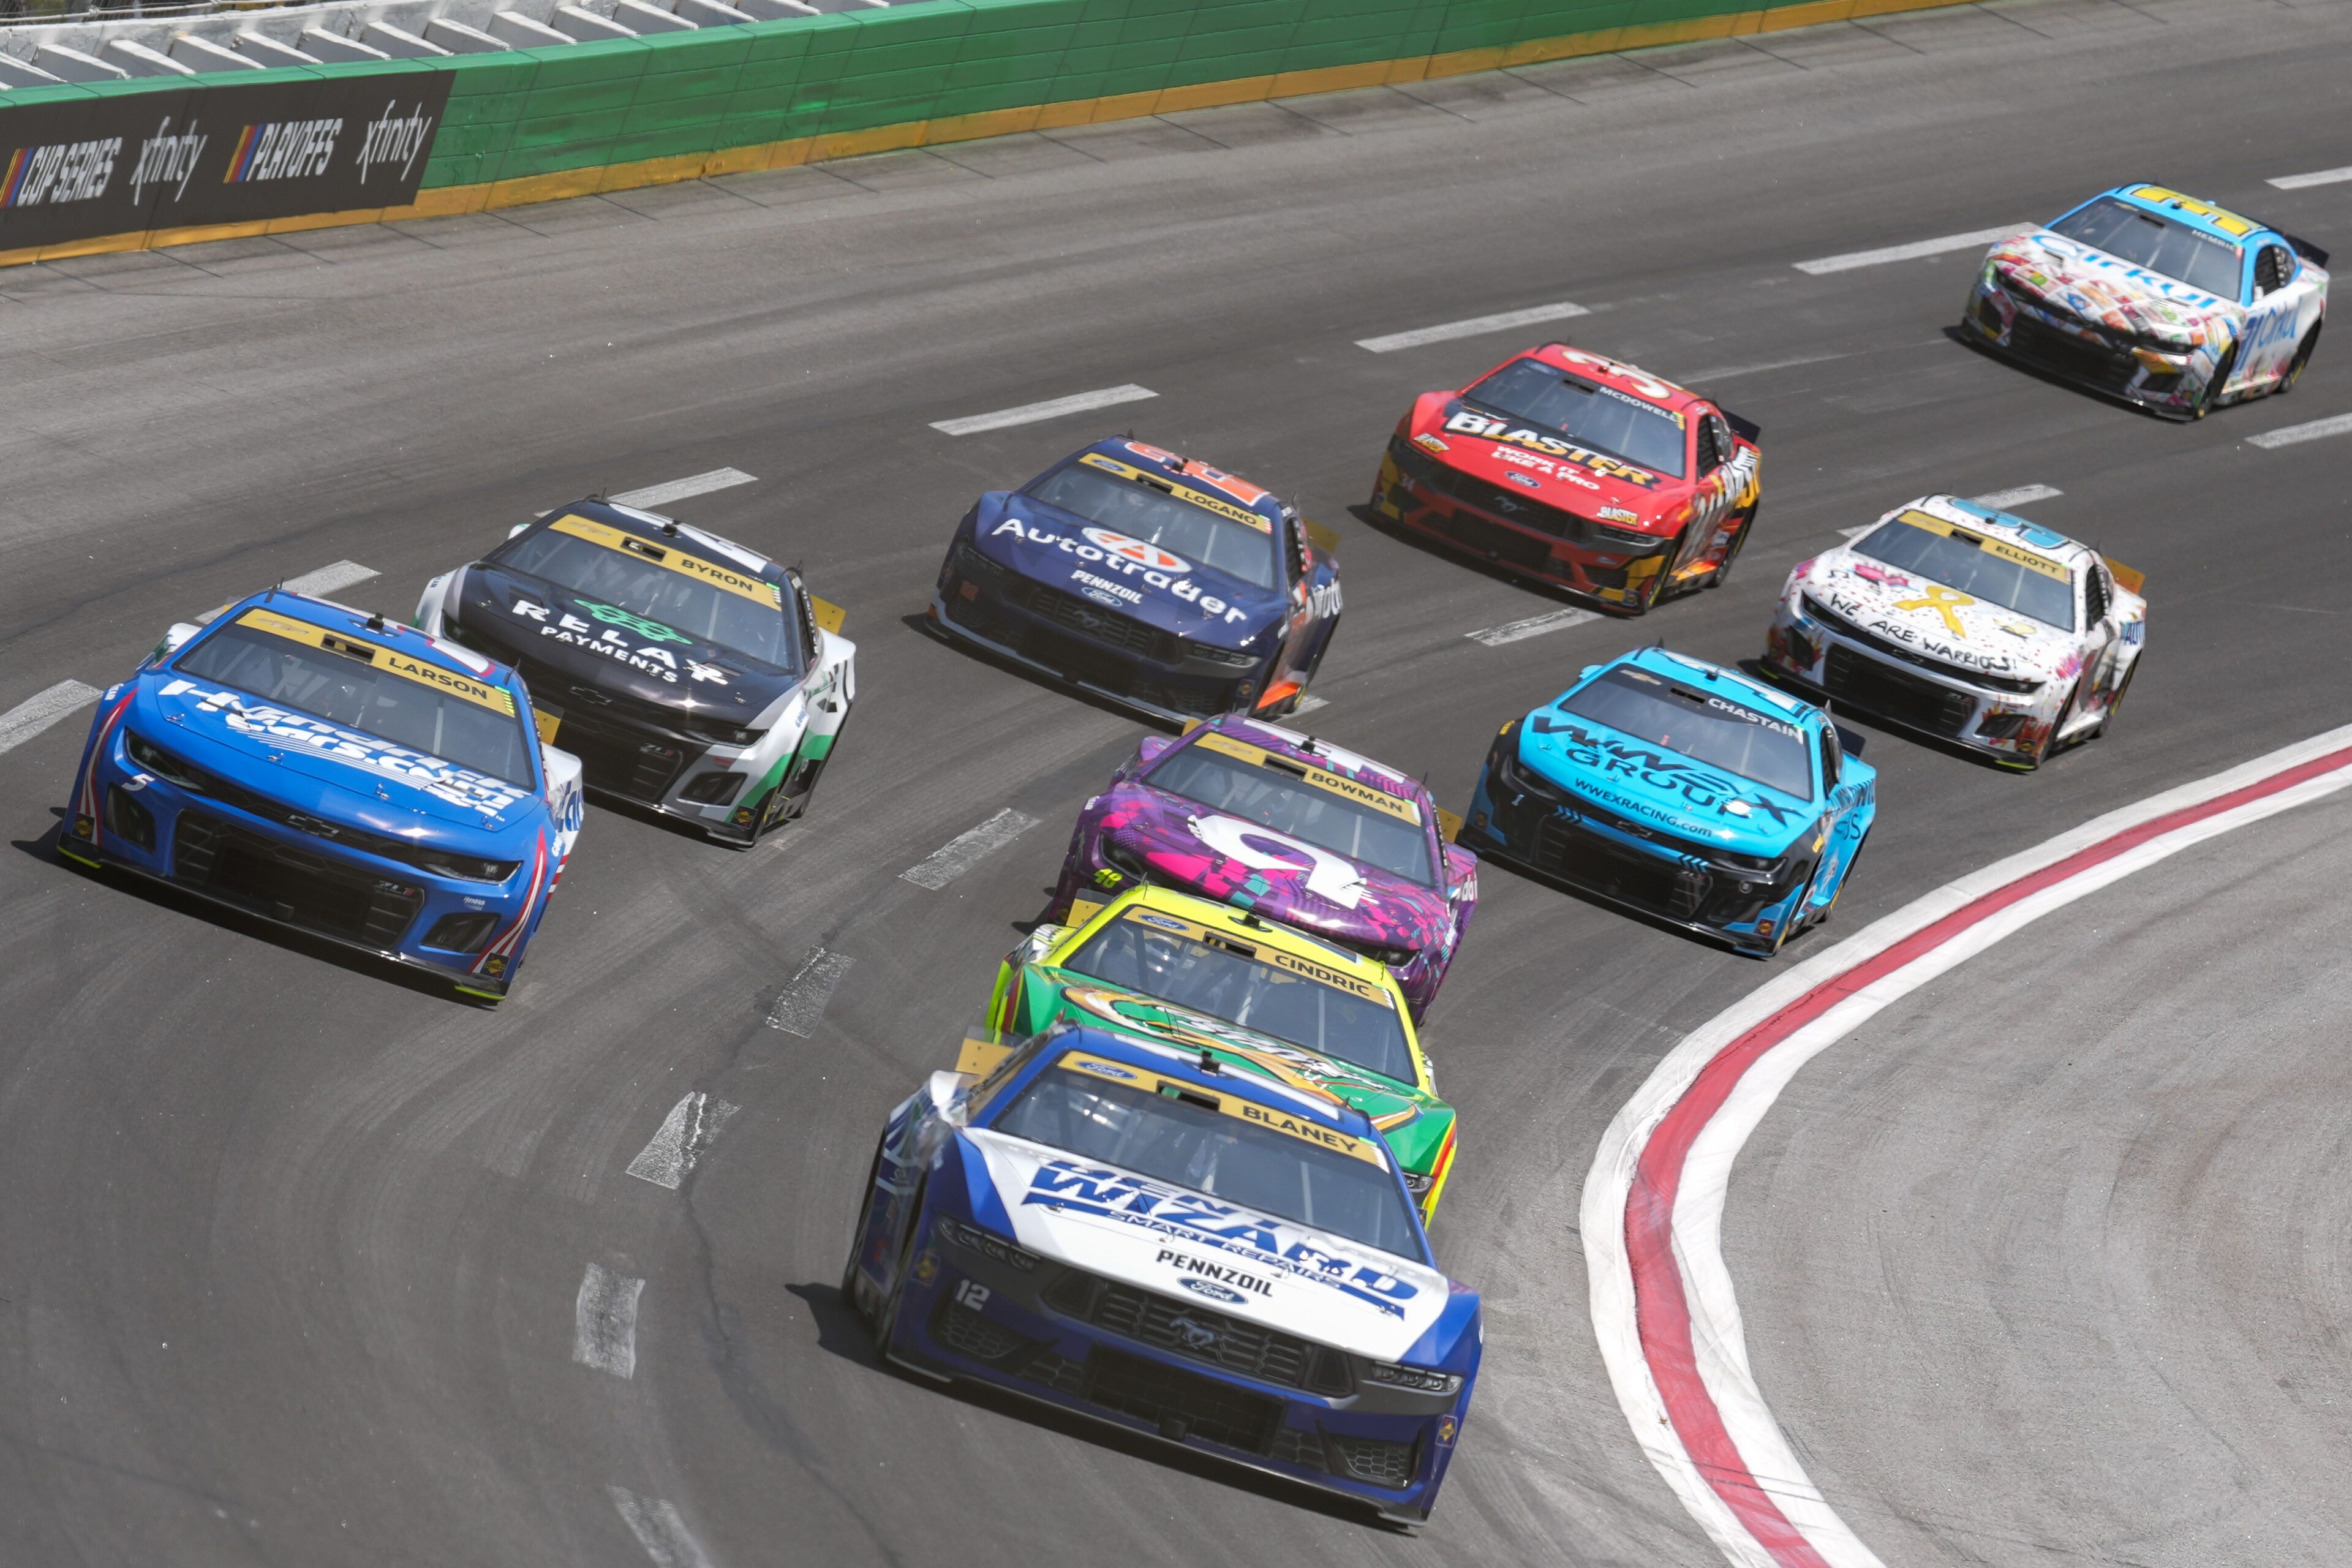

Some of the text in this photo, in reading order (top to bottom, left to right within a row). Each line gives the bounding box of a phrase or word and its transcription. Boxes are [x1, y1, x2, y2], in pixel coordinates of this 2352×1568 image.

[129, 115, 208, 206] xfinity
[246, 118, 343, 181] PLAYOFFS
[356, 99, 432, 184] xfinity
[17, 137, 122, 206] CUP SERIES
[1599, 386, 1678, 422] MCDOWELL
[1446, 411, 1655, 486] BLASTER
[1497, 445, 1580, 475] WORK IT
[1491, 450, 1600, 491] LIKE A PRO
[1184, 491, 1257, 525] LOGANO
[681, 559, 753, 592] BYRON
[991, 518, 1248, 624] Autotrader
[1996, 545, 2058, 573] ELLIOTT
[1071, 569, 1144, 605] PENNZOIL
[1830, 593, 1863, 617] WE
[1869, 620, 1915, 642] ARE
[540, 626, 678, 683] PAYMENTS
[388, 657, 488, 700] LARSON
[1708, 698, 1804, 745] CHASTAIN
[121, 773, 156, 791] 5
[1311, 772, 1403, 813] BOWMAN
[1575, 777, 1713, 839] WWEXRACING.com
[1144, 914, 1182, 931] Ford
[1274, 954, 1371, 997] CINDRIC
[1083, 1060, 1129, 1079] Ford
[1243, 1104, 1359, 1153] BLANEY
[1030, 1166, 1419, 1301] WIZARD
[1106, 1209, 1208, 1243] SMART
[1155, 1248, 1273, 1297] PENNZOIL
[1221, 1240, 1342, 1289] REPAIRS
[956, 1278, 990, 1312] 12
[1188, 1279, 1239, 1302] Ford
